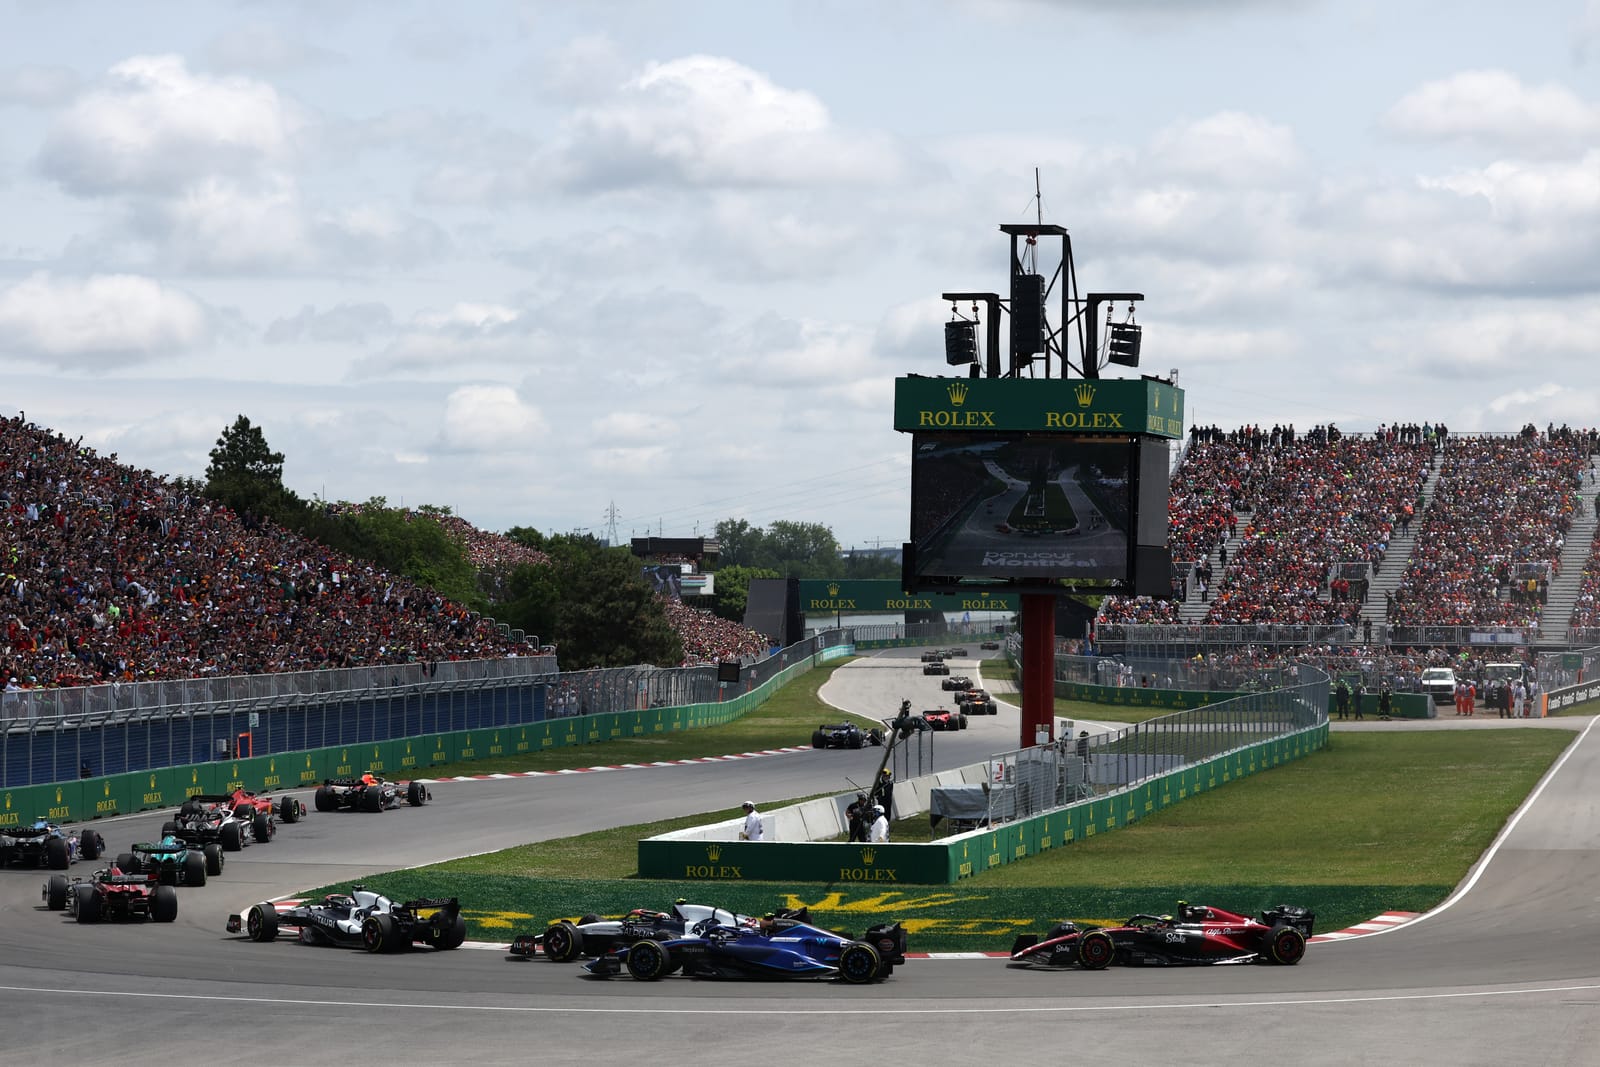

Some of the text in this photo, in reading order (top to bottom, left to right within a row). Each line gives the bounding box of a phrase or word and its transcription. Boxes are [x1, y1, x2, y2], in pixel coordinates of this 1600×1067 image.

[919, 411, 1124, 428] ROLEX ROLEX
[810, 599, 1008, 610] ROLEX ROLEX ROLEX
[143, 792, 162, 804] ROLEX
[97, 799, 117, 812] ROLEX
[49, 807, 70, 818] ROLEX
[685, 865, 898, 881] ROLEX ROLEX
[1165, 932, 1187, 943] Stake
